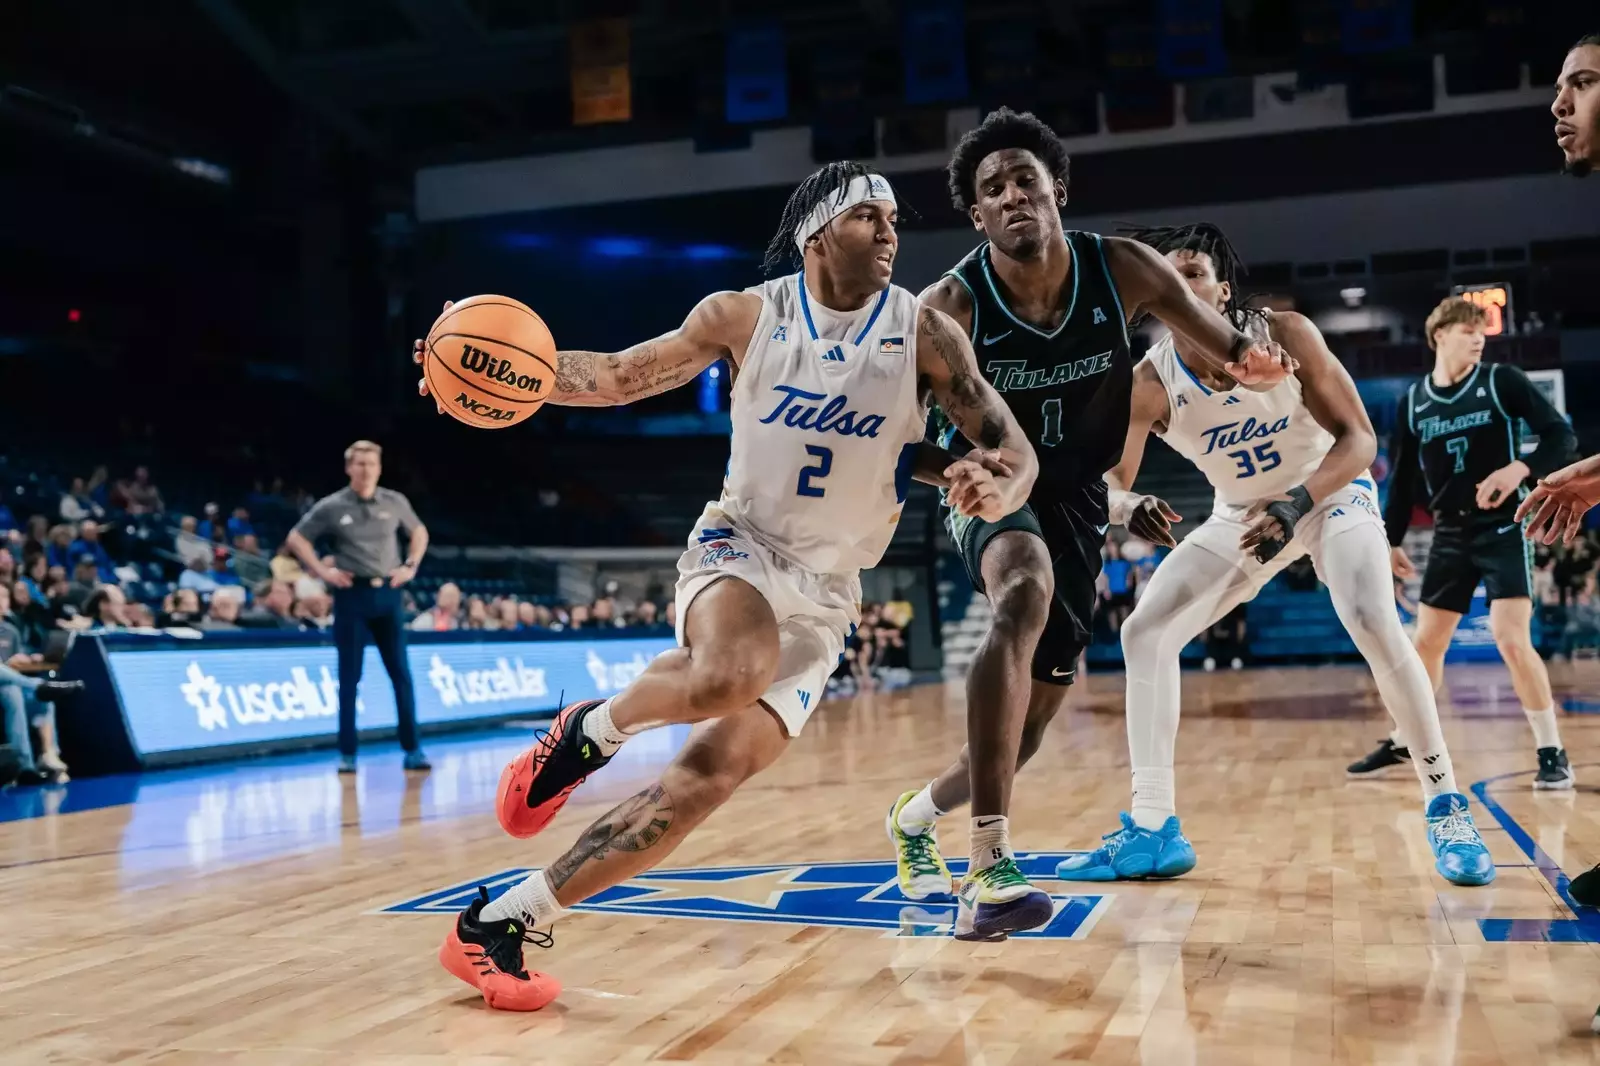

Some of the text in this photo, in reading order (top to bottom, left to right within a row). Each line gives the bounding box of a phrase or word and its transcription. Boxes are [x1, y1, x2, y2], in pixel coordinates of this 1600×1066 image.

[460, 343, 542, 393] Wilson
[454, 392, 517, 421] NCAA
[759, 385, 886, 438] Tulsa
[1041, 398, 1063, 447] 1
[1200, 415, 1289, 455] Tulsa
[1446, 434, 1468, 473] 7
[796, 443, 833, 497] 2
[1227, 440, 1282, 479] 35
